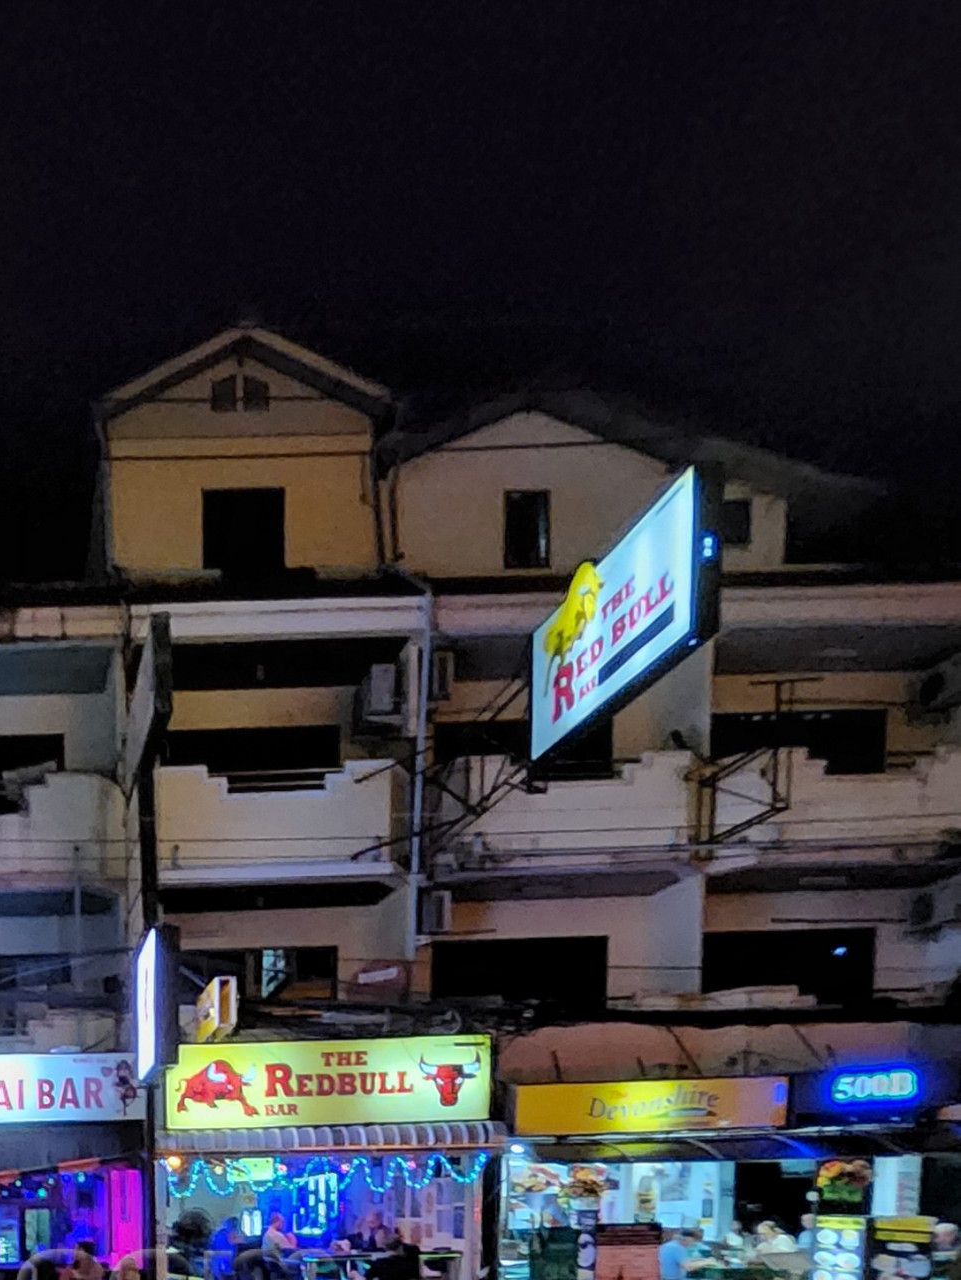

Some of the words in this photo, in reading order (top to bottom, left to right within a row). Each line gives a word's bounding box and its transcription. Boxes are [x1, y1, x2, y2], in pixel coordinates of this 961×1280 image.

[552, 636, 604, 724] RED
[610, 572, 674, 647] BULL
[321, 1051, 368, 1067] THE
[37, 1077, 104, 1110] BAR
[265, 1104, 298, 1117] BAR
